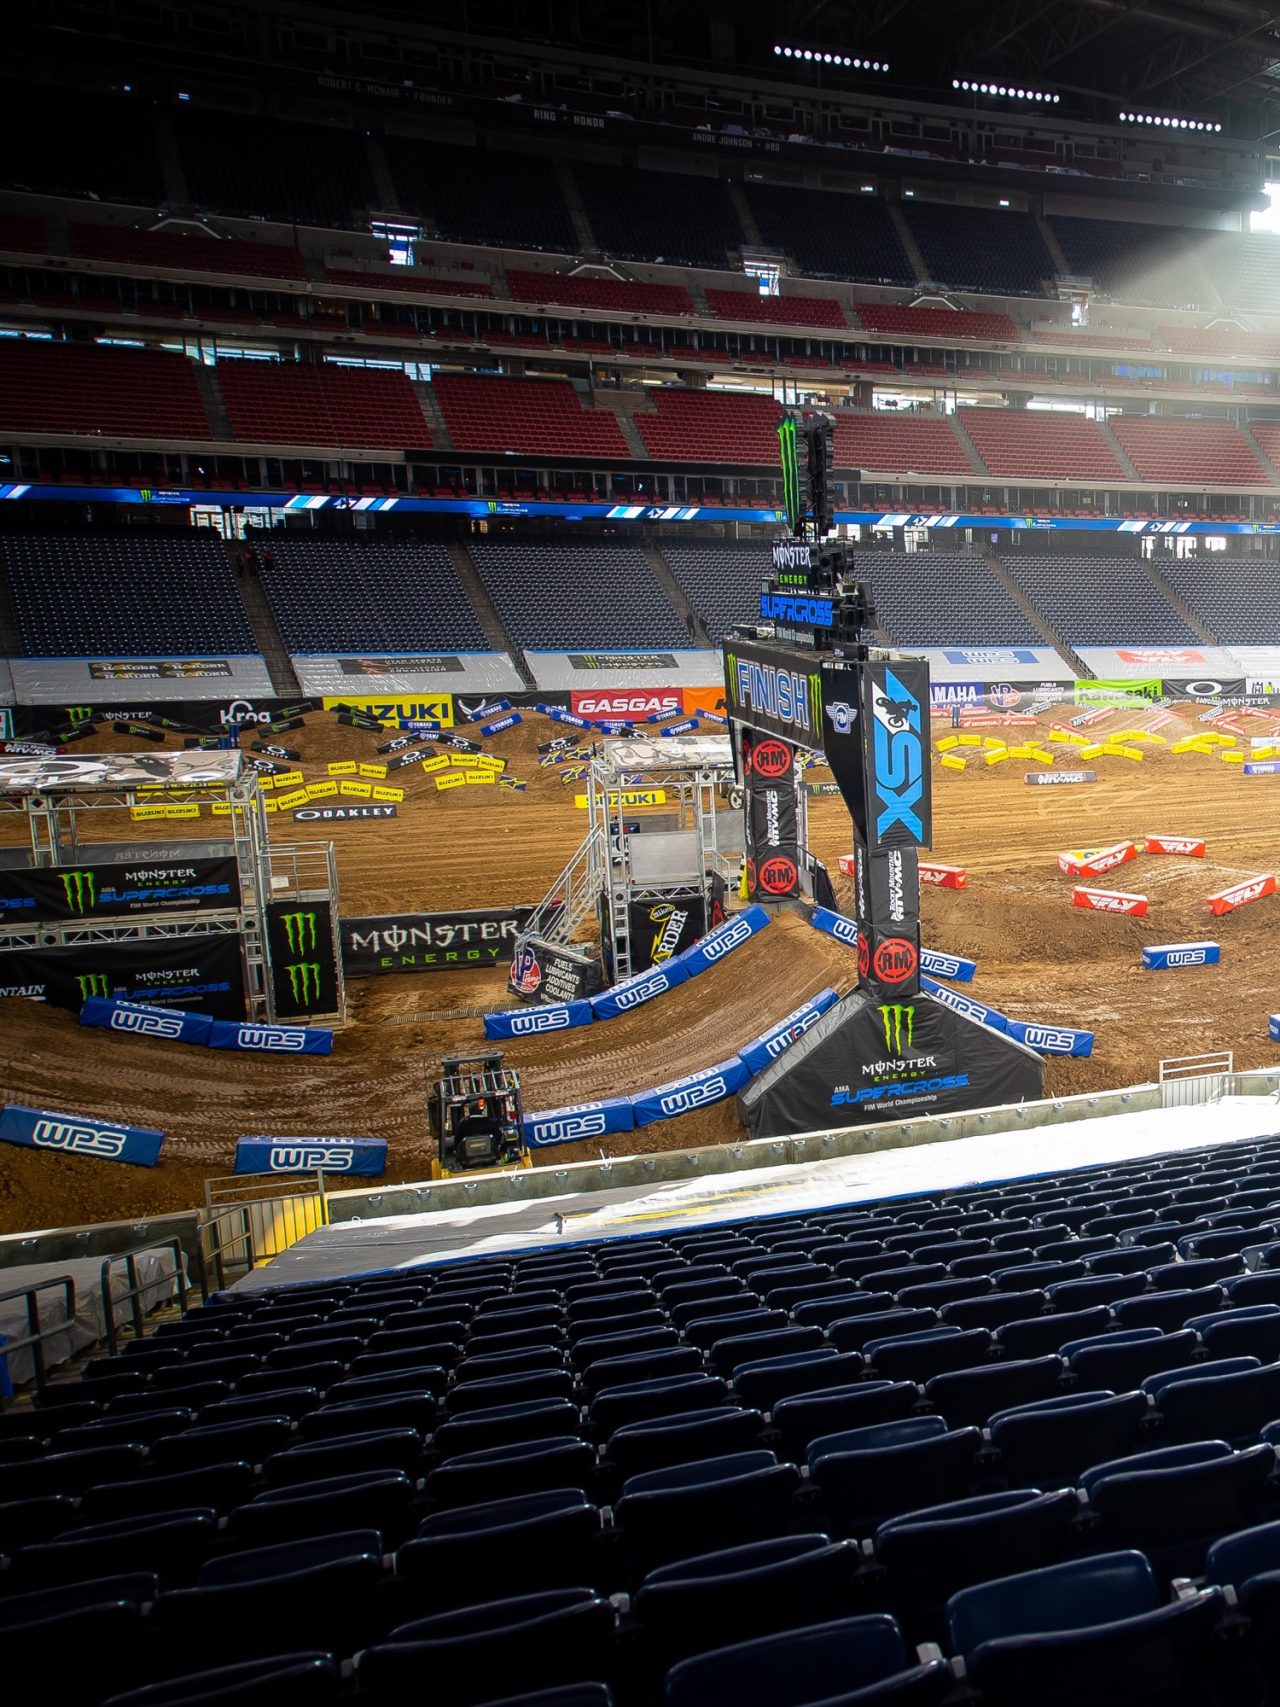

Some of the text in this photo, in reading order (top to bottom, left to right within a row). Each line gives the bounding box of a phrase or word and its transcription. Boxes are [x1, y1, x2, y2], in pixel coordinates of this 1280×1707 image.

[773, 543, 812, 569] MONSTER
[780, 575, 807, 585] ENERGY
[761, 595, 833, 627] SUPERCROSS
[737, 658, 810, 731] FINISH
[1223, 696, 1270, 706] MONSTER
[330, 703, 449, 720] UZUKI
[578, 697, 678, 713] GASGAS
[495, 718, 513, 728] YAMAHA
[309, 785, 336, 795] SUZUKI
[375, 790, 402, 798] SUZUKI
[167, 807, 196, 815] SUZUKI
[323, 808, 394, 818] OAKLEY
[1163, 841, 1199, 852] FLY
[1095, 848, 1127, 869] FLY
[125, 868, 197, 881] MONSTER
[138, 879, 187, 887] ENERGY
[768, 868, 790, 883] RM
[99, 884, 230, 902] SUPERCROSS
[1231, 882, 1266, 904] FLY
[1096, 897, 1138, 911] FLY
[350, 920, 524, 953] MONSTER
[703, 920, 751, 961] WPS
[381, 948, 499, 967] ENERGY
[554, 959, 572, 971] FUELS
[881, 952, 908, 970] RM
[920, 953, 960, 977] WPS
[1167, 950, 1206, 967] WPS
[135, 968, 200, 981] MONSTER
[545, 964, 580, 984] LUBRICANTS
[112, 982, 231, 1000] SUPERCROSS
[545, 984, 575, 1001] COOLANTS
[547, 975, 575, 992] ADDITIVES
[616, 974, 668, 1009] WPS
[936, 987, 987, 1022] WPS
[111, 1010, 183, 1038] WPS
[511, 1010, 570, 1035] WPS
[238, 1029, 305, 1050] WPS
[1025, 1028, 1075, 1052] WPS
[862, 1056, 936, 1076] MONSTER
[874, 1070, 926, 1083] ENERGY
[660, 1077, 726, 1115] WPS
[830, 1074, 970, 1107] SUPERCROSS
[834, 1085, 850, 1093] AMA
[864, 1094, 937, 1112] FIM World Championship
[534, 1114, 606, 1144] WPS
[33, 1120, 127, 1157] WPS
[270, 1148, 353, 1171] WPS
